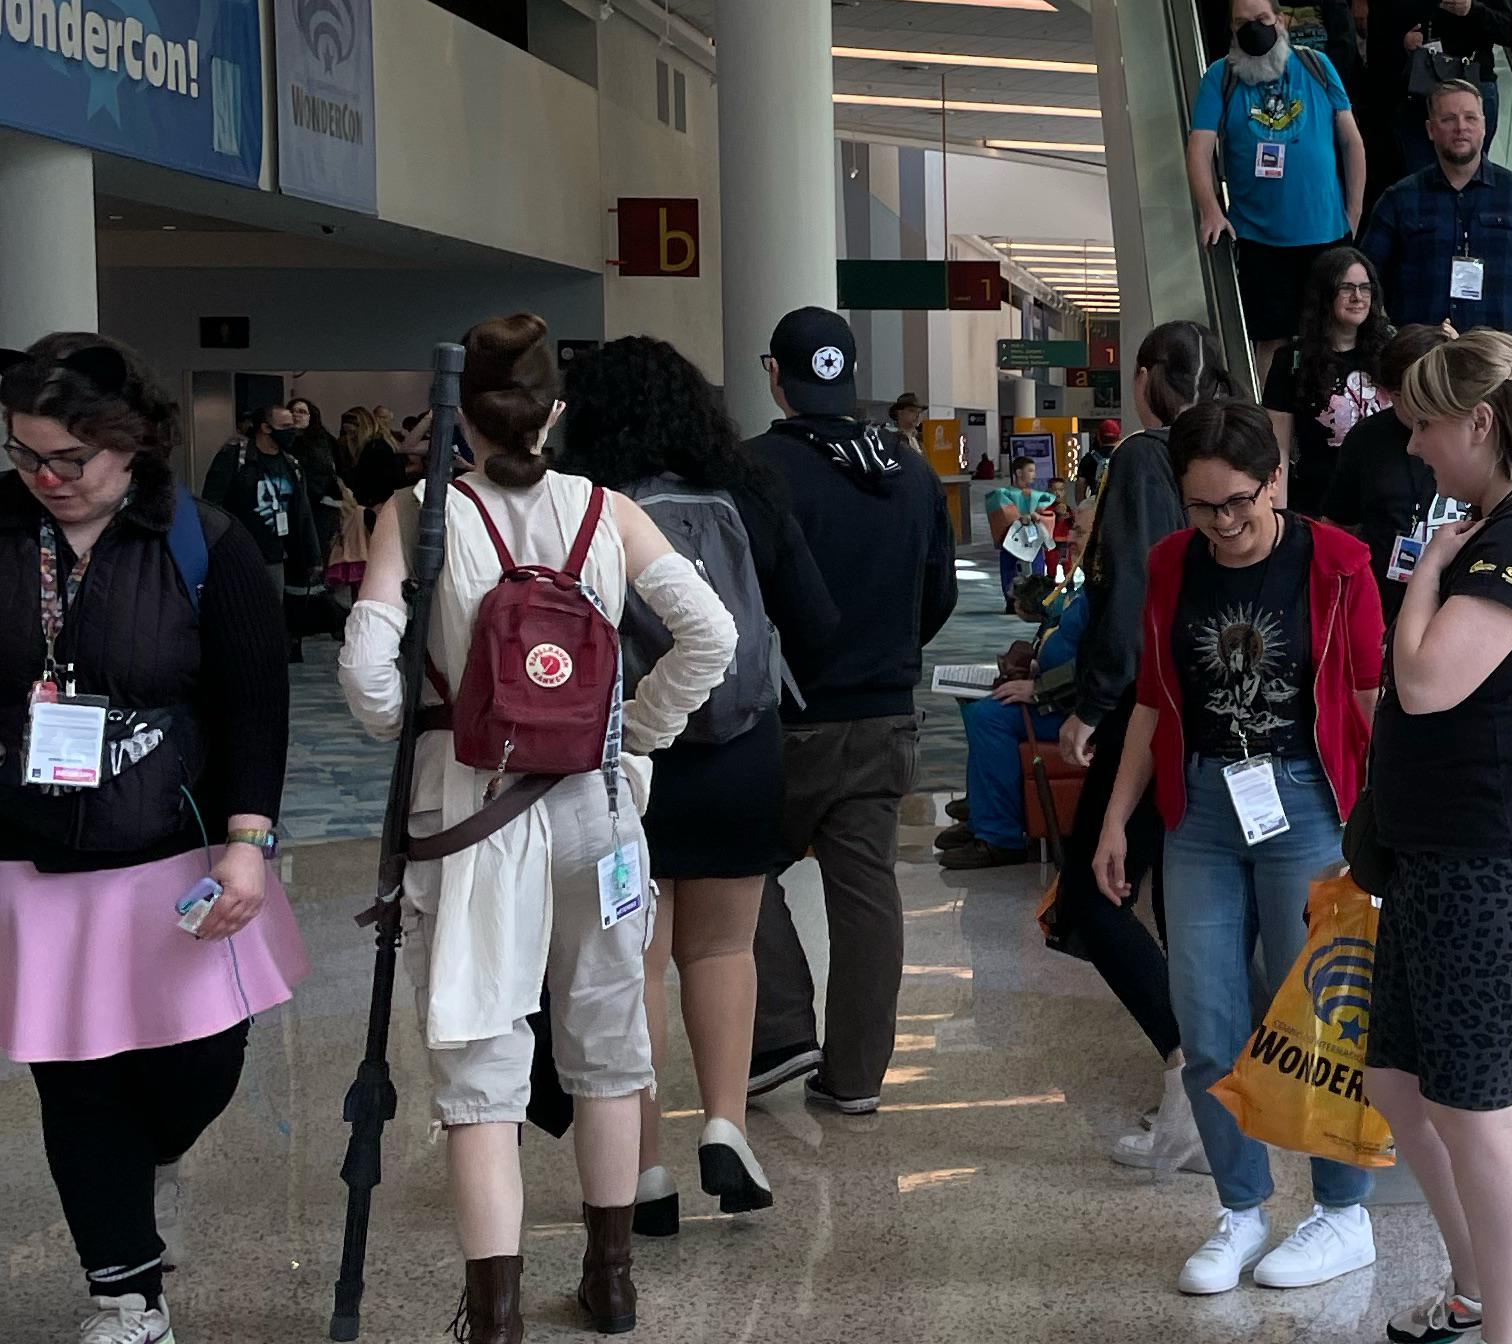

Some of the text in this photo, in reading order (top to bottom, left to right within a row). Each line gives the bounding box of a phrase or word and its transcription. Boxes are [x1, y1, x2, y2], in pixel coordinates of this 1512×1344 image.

[659, 207, 695, 272] b
[981, 278, 992, 301] 1
[1105, 348, 1114, 364] 1
[1076, 371, 1088, 387] a
